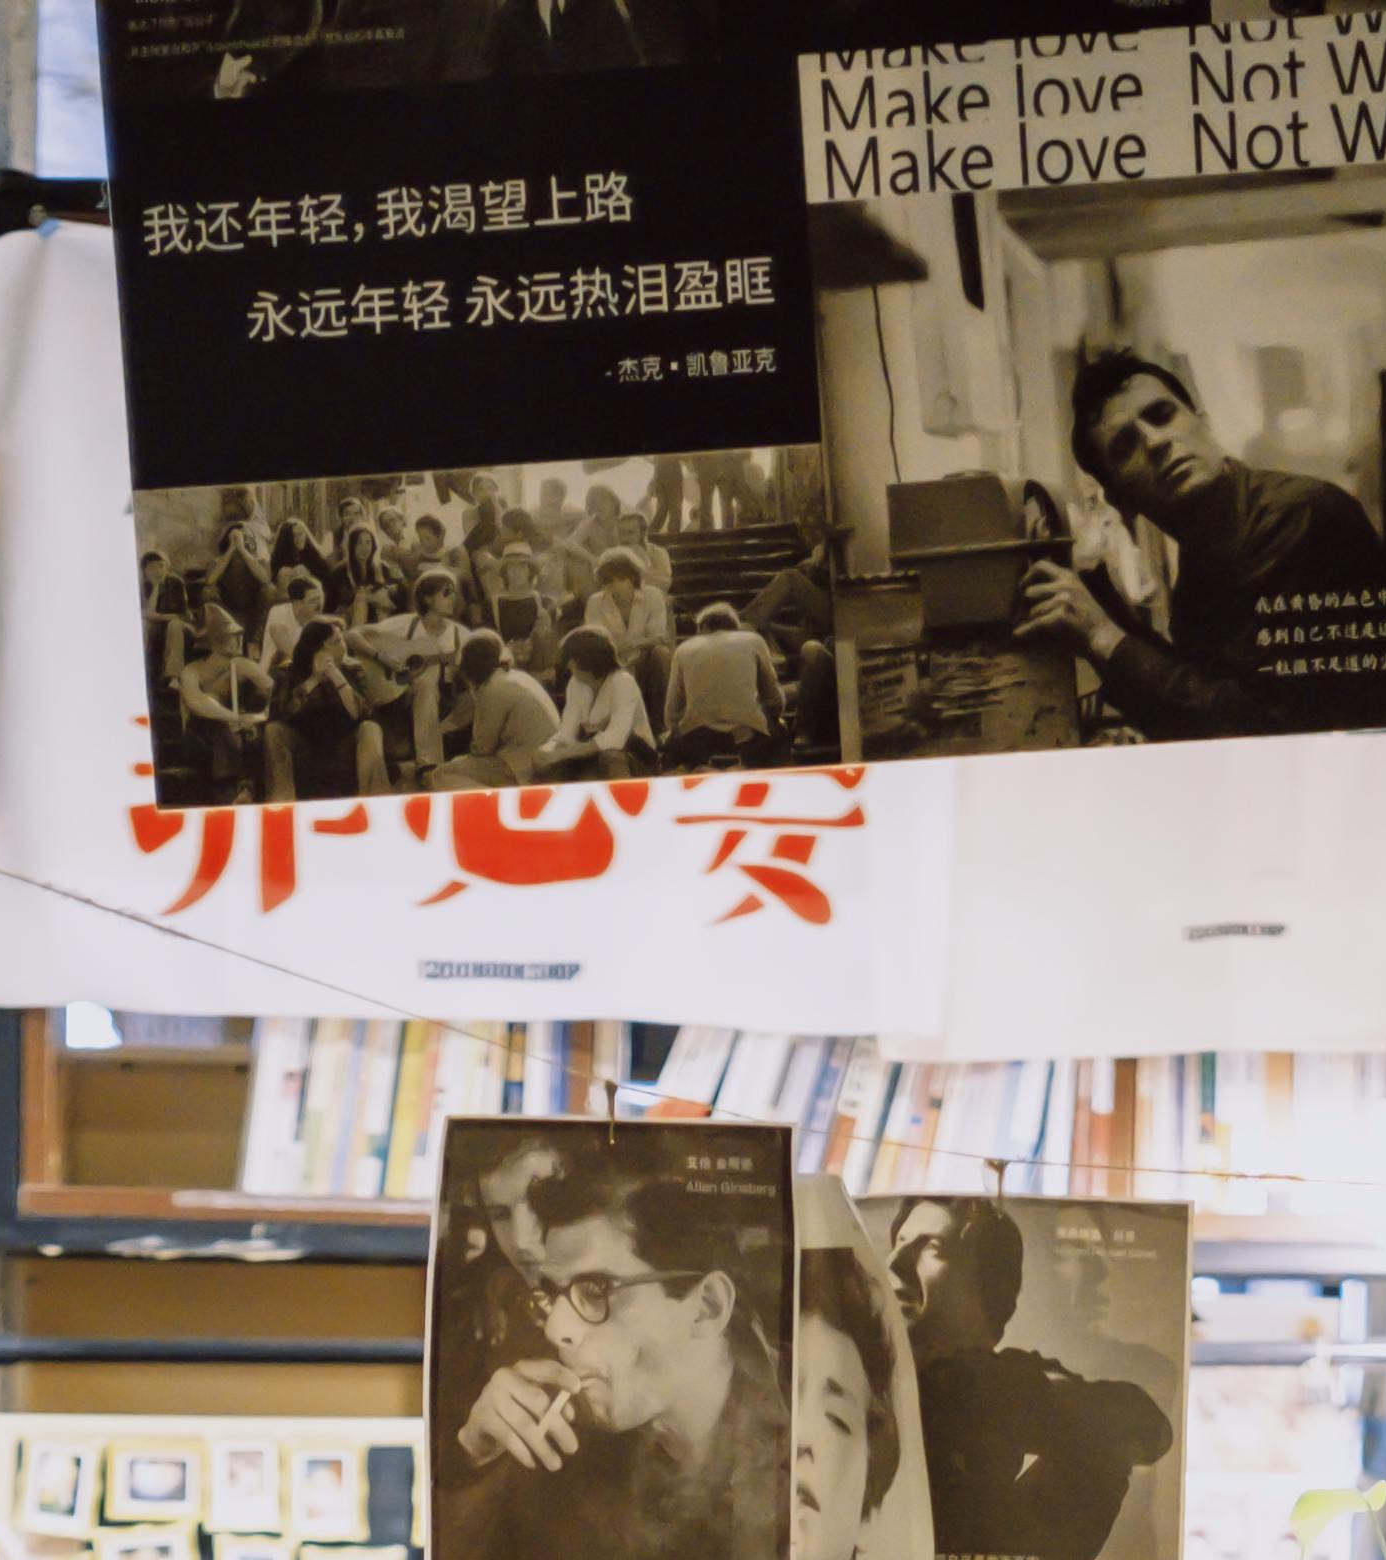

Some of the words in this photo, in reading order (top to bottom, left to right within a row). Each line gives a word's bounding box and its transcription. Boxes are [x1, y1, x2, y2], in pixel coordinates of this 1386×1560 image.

[822, 69, 991, 131] Make
[1014, 64, 1144, 119] love
[1189, 50, 1306, 105] Not
[824, 130, 994, 201] Make
[1019, 123, 1147, 188] love
[1192, 111, 1309, 175] Not
[247, 279, 451, 343] 永远年轻
[466, 256, 776, 326] 永远热泪盈眶
